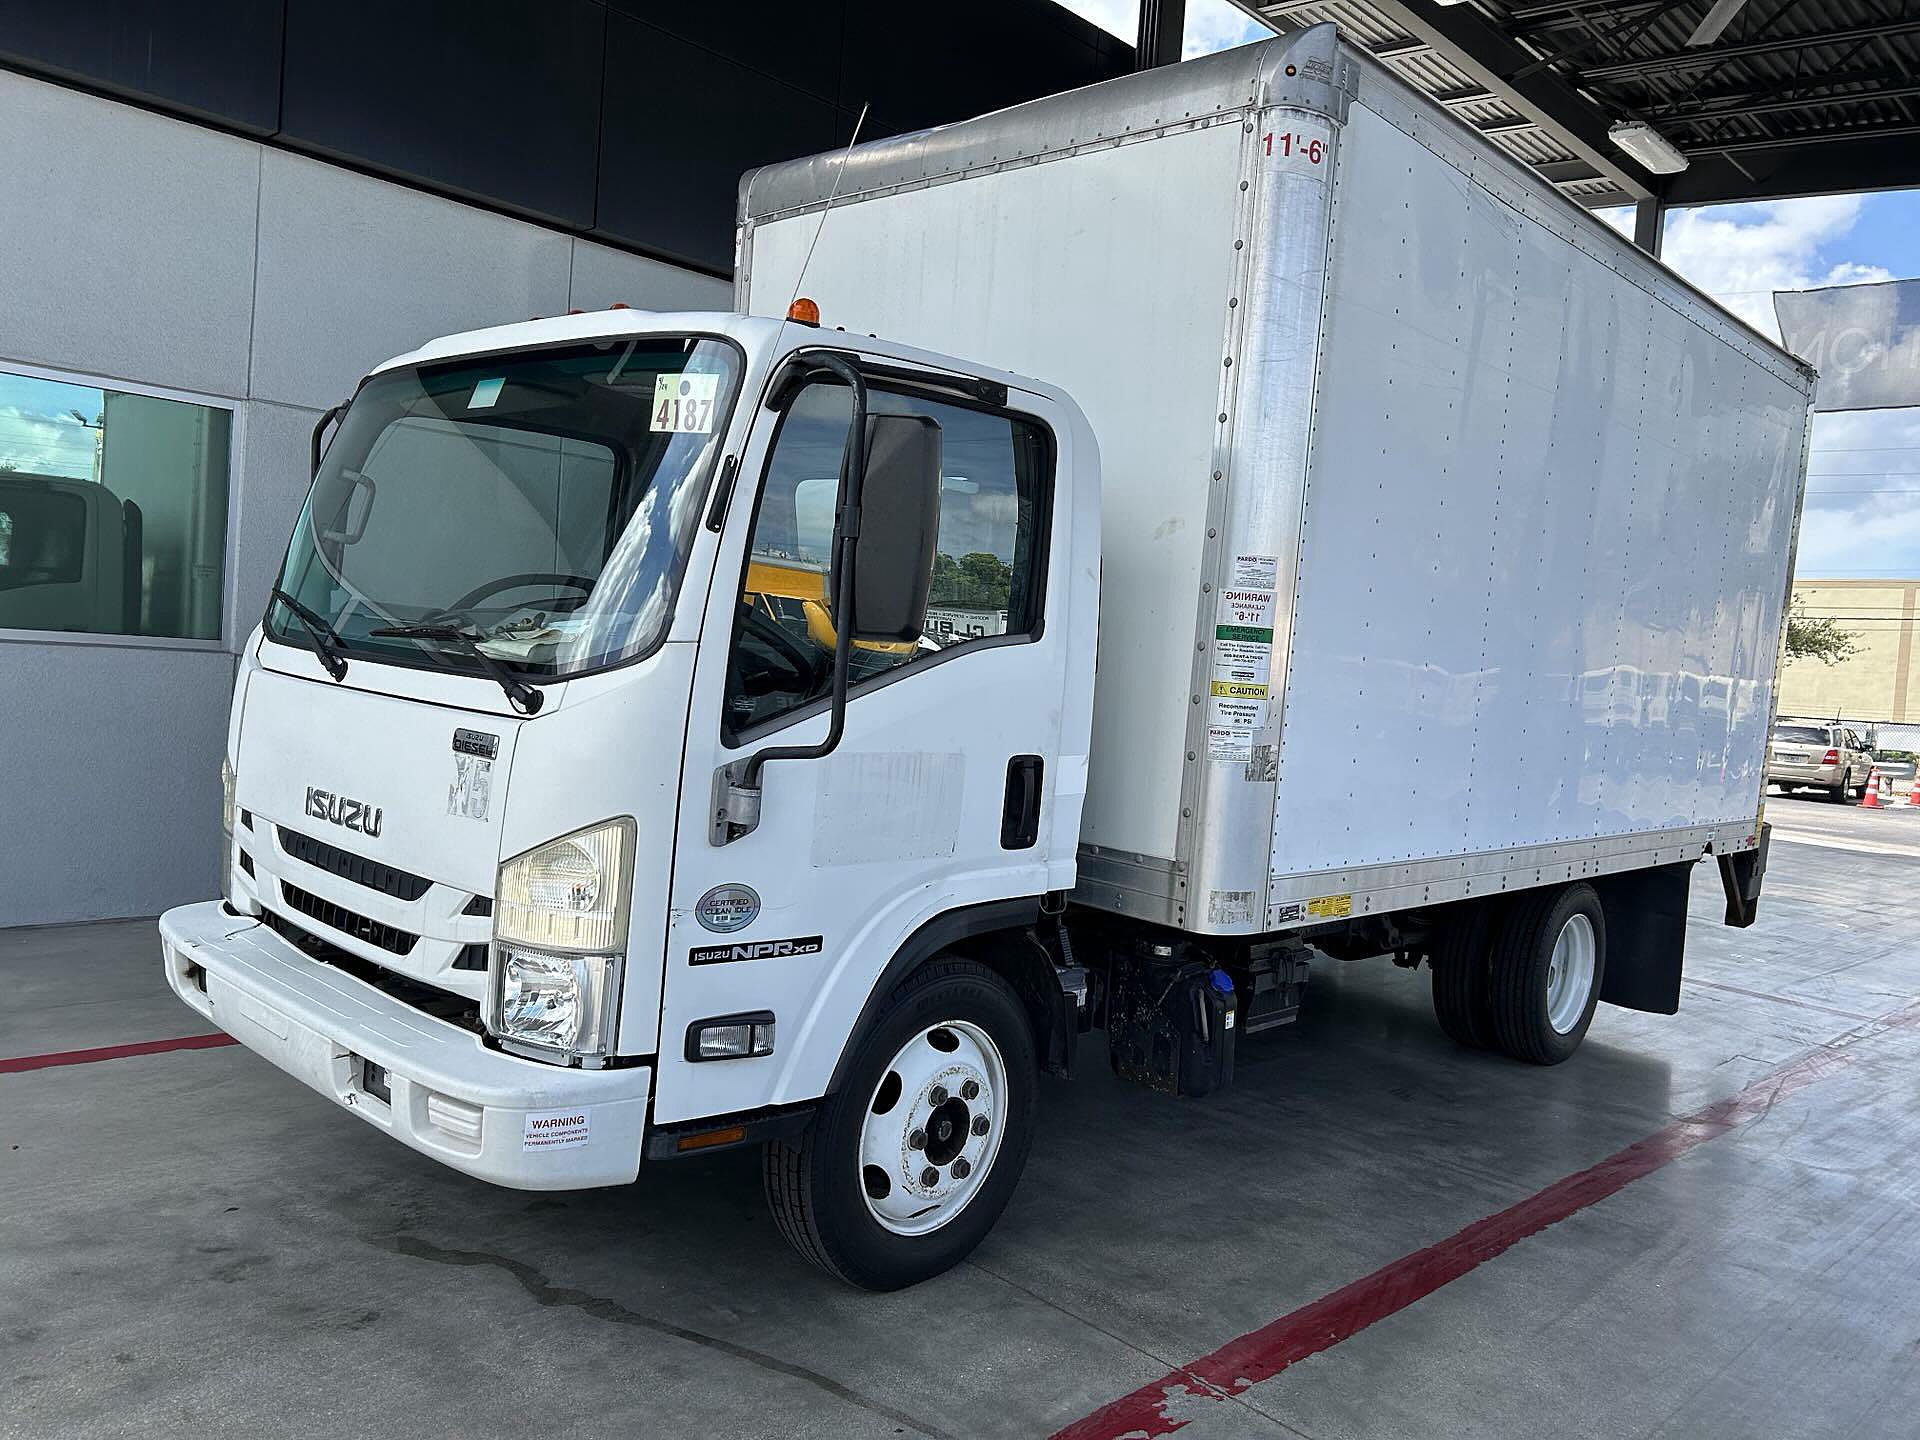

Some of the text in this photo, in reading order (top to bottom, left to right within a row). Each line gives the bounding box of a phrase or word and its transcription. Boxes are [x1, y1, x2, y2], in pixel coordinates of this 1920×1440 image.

[656, 399, 712, 431] 4187
[1229, 686, 1265, 696] CAUTION
[1218, 703, 1258, 711] Recommended
[453, 739, 493, 756] DIESEL
[305, 786, 383, 838] ISUZU
[709, 898, 749, 907] CERTIFIED
[705, 906, 732, 915] CLEAN
[694, 950, 730, 962] ISUZU
[532, 1116, 585, 1129] WARNING
[524, 1139, 565, 1147] PERMANENTLY
